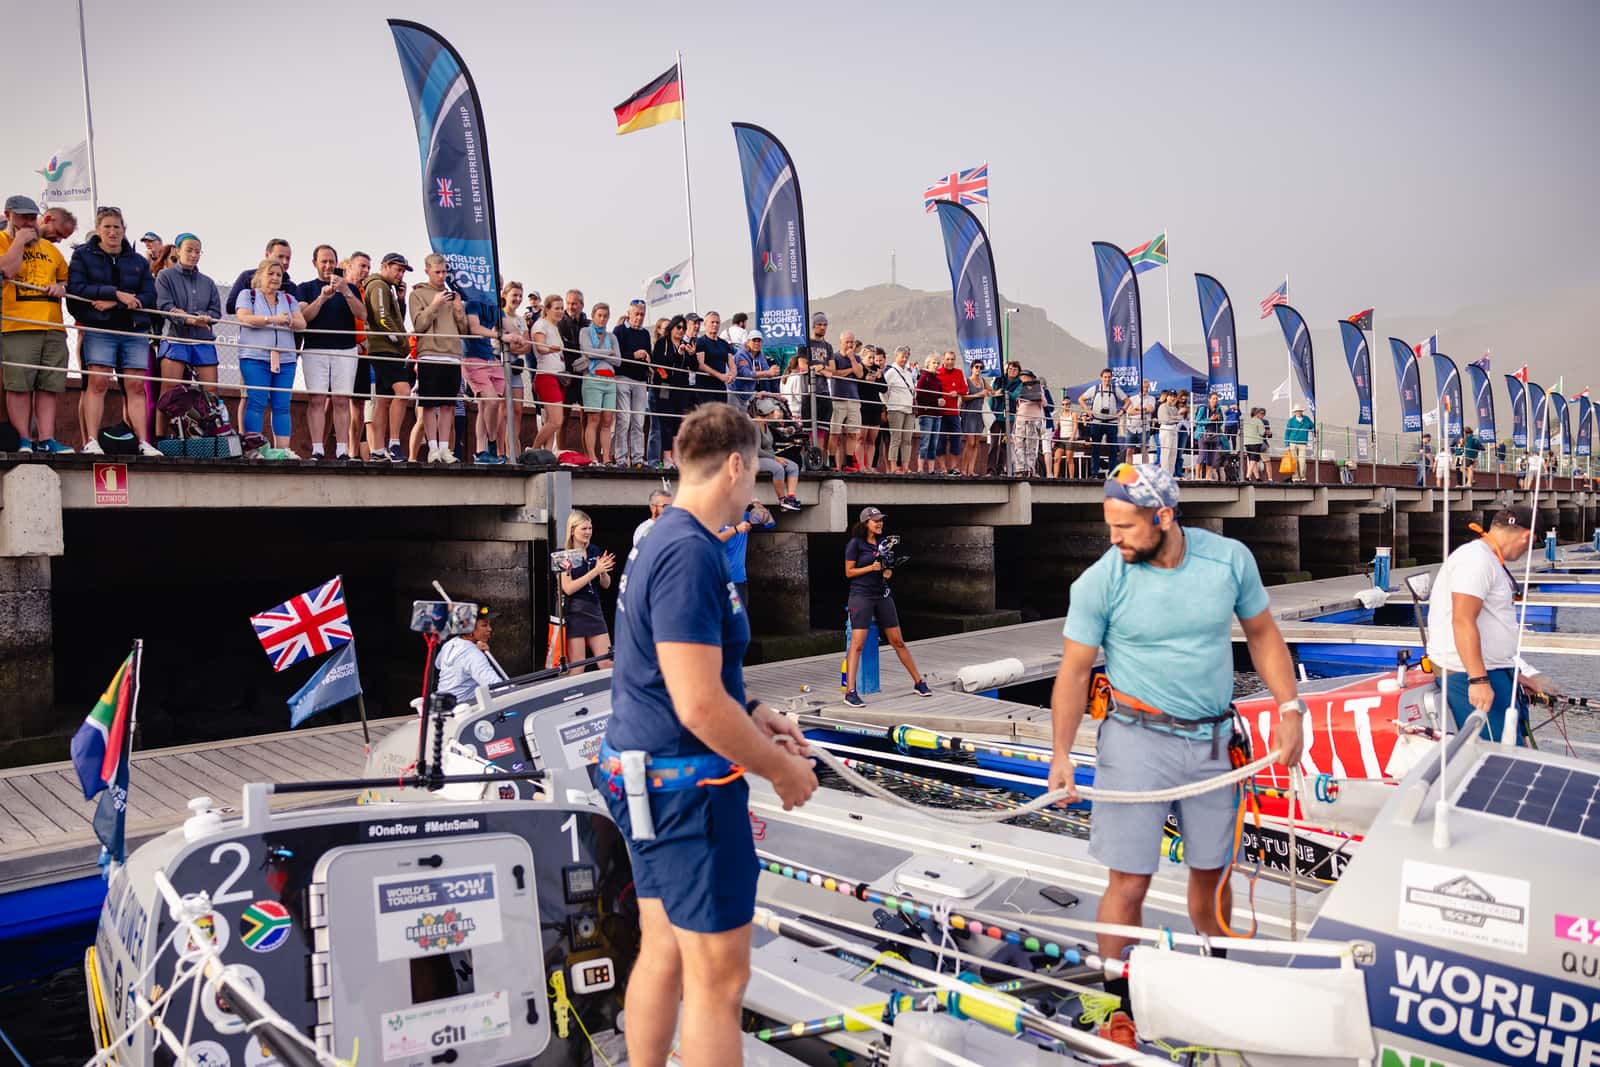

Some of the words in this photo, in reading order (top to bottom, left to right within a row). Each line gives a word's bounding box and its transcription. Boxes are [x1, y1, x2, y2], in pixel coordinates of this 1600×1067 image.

[460, 106, 472, 128] SHIP
[464, 130, 481, 203] ENTREPRENEUR
[473, 204, 483, 223] THE
[787, 220, 796, 247] ROWER
[445, 262, 491, 274] OUGHEST
[789, 248, 798, 283] FREEDOM
[760, 315, 802, 324] TOUGHEST
[762, 308, 799, 318] WORLD'S
[368, 823, 418, 837] #OneRow
[424, 818, 480, 833] #MetnSmile
[561, 813, 581, 863] 1
[210, 842, 254, 905] 2
[386, 884, 430, 899] WORLD'S
[387, 891, 438, 907] TOUGHEST
[432, 1025, 467, 1047] Gill
